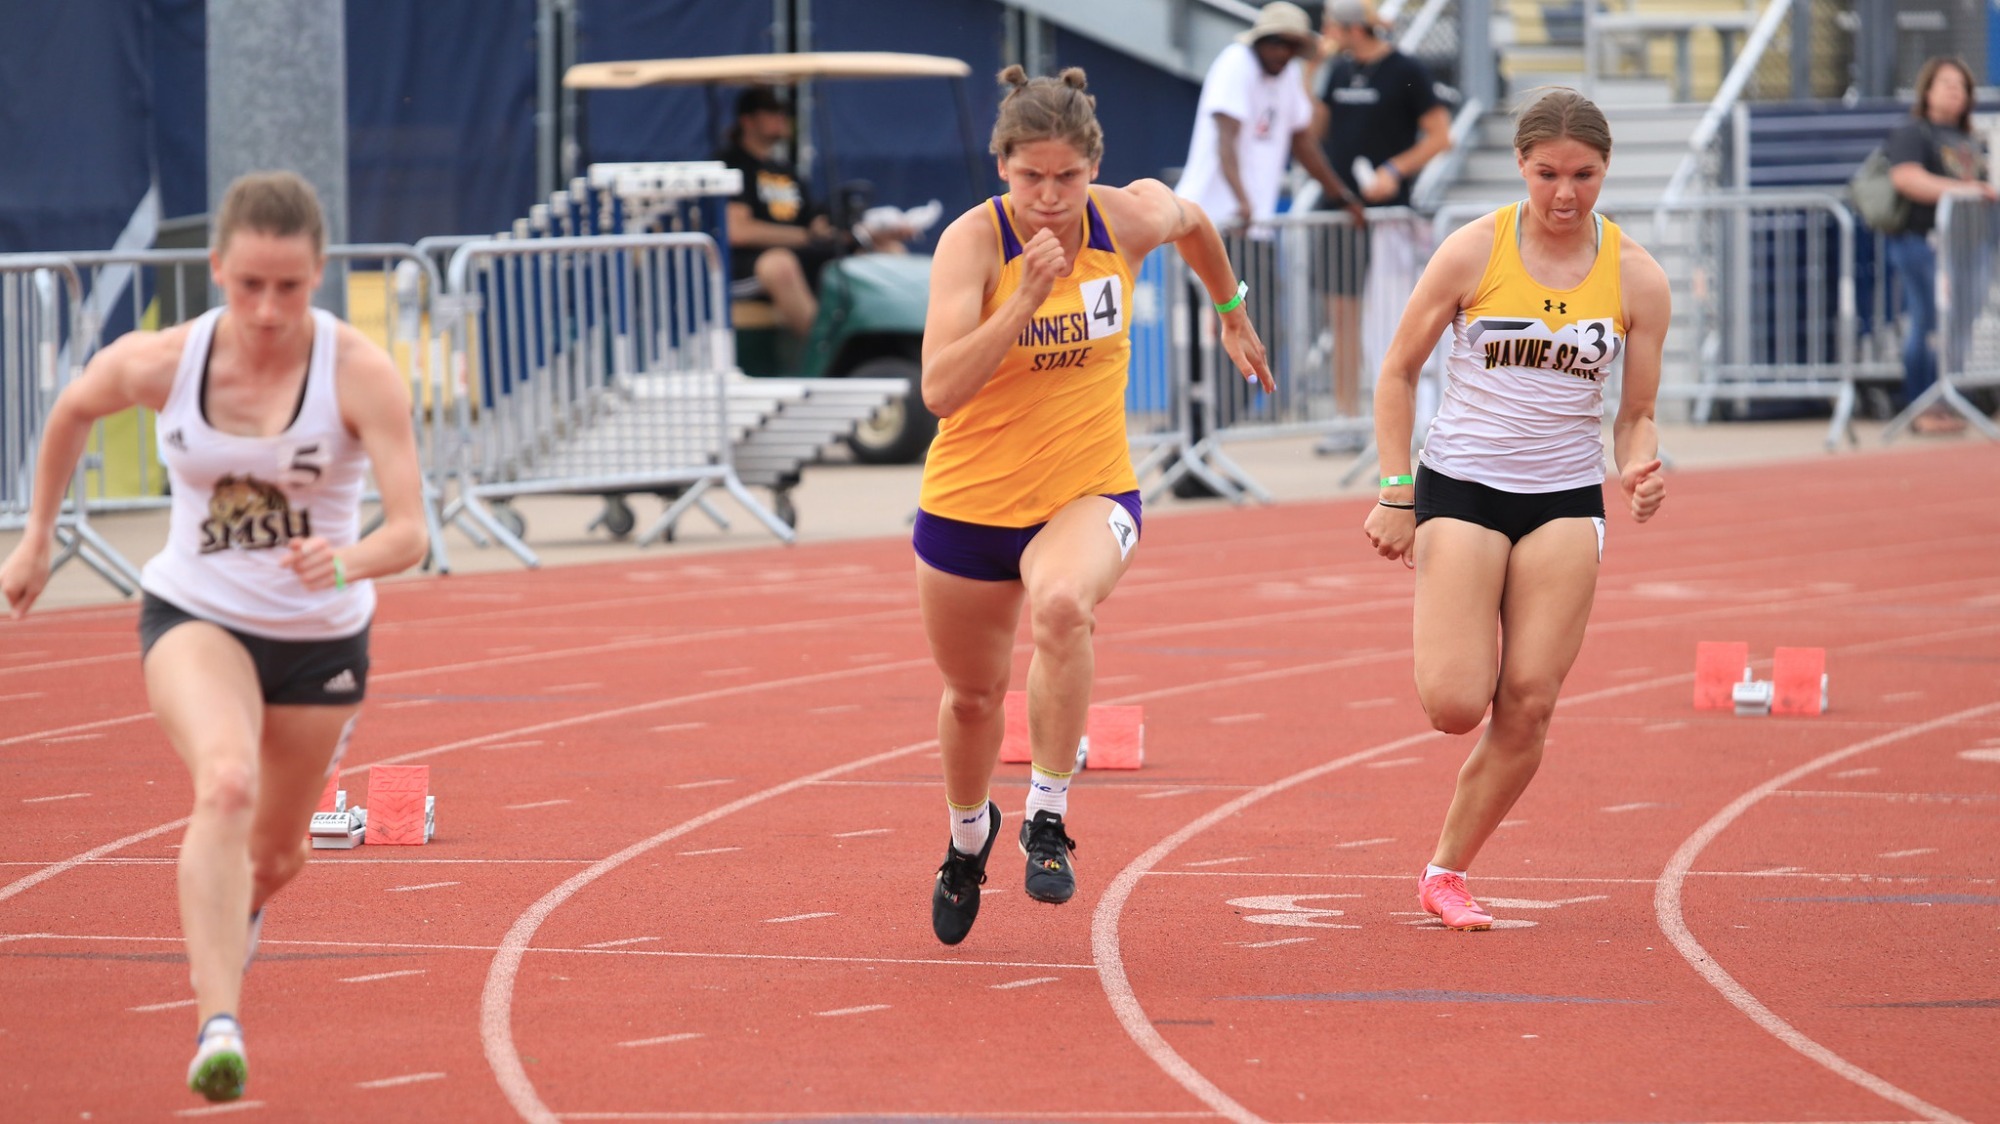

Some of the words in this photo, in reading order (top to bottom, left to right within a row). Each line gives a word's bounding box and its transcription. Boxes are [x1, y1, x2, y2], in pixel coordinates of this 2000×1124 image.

[1093, 280, 1118, 327] 4
[1018, 311, 1090, 347] INNES
[1580, 321, 1608, 365] 3
[1030, 346, 1093, 373] STATE
[1485, 339, 1553, 370] WAYNE
[290, 444, 322, 487] 5
[199, 508, 312, 554] SMSU
[313, 813, 347, 821] GILL
